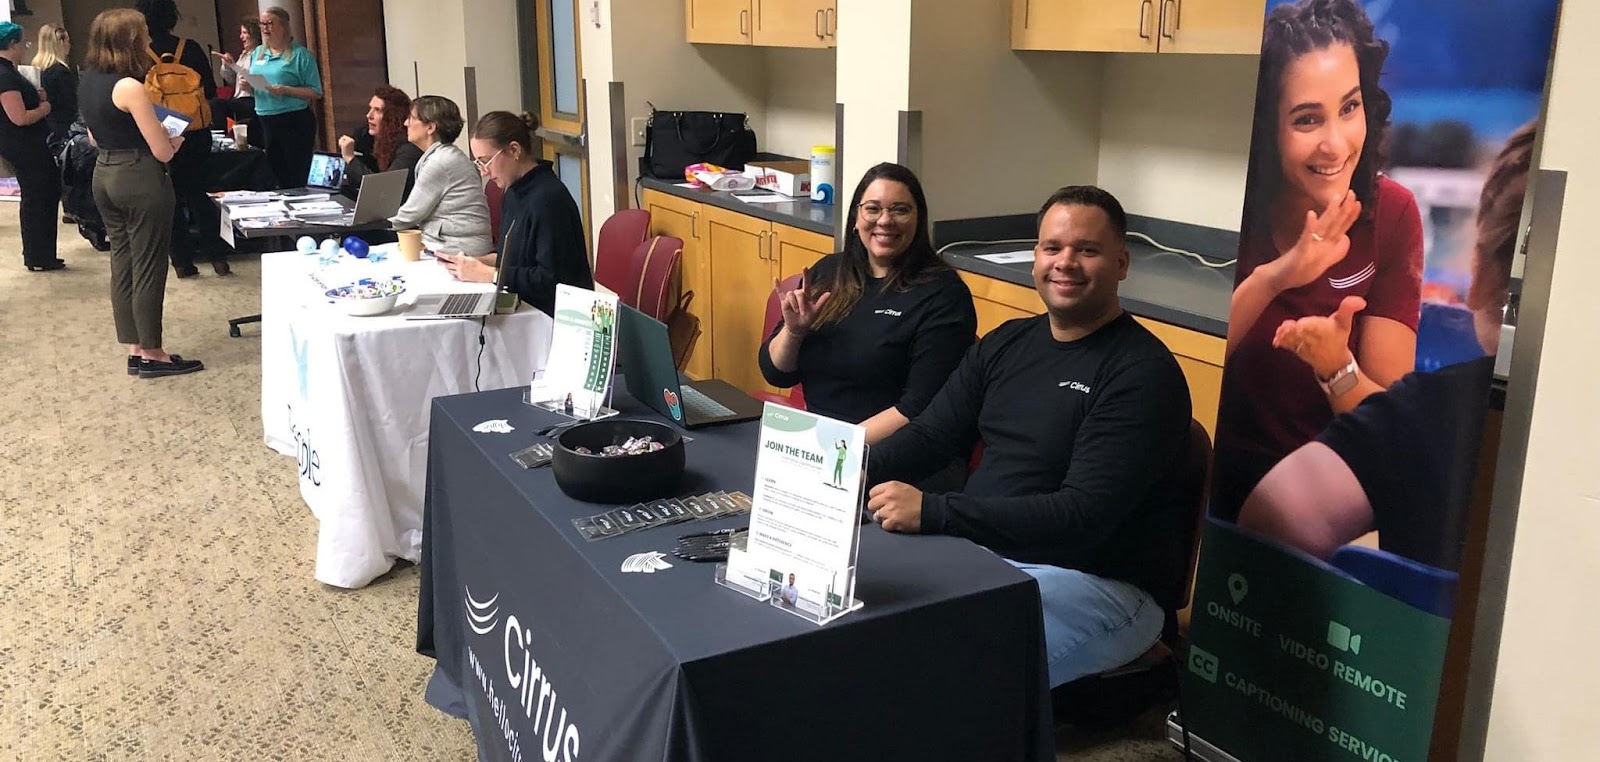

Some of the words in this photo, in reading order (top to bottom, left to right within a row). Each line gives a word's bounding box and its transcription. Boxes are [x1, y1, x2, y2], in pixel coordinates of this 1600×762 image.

[1070, 381, 1091, 393] Cirrus
[765, 440, 784, 453] JOIN
[785, 446, 800, 458] THE
[801, 450, 824, 464] TEAM
[1207, 601, 1262, 638] ONSITE
[467, 646, 523, 762] www.hellocir
[504, 615, 580, 762] Cirrus
[1279, 634, 1330, 670] VIDEO
[1333, 659, 1408, 710] REMOTE
[1224, 671, 1325, 734] CAPTIONING
[1328, 726, 1400, 762] SERVI
